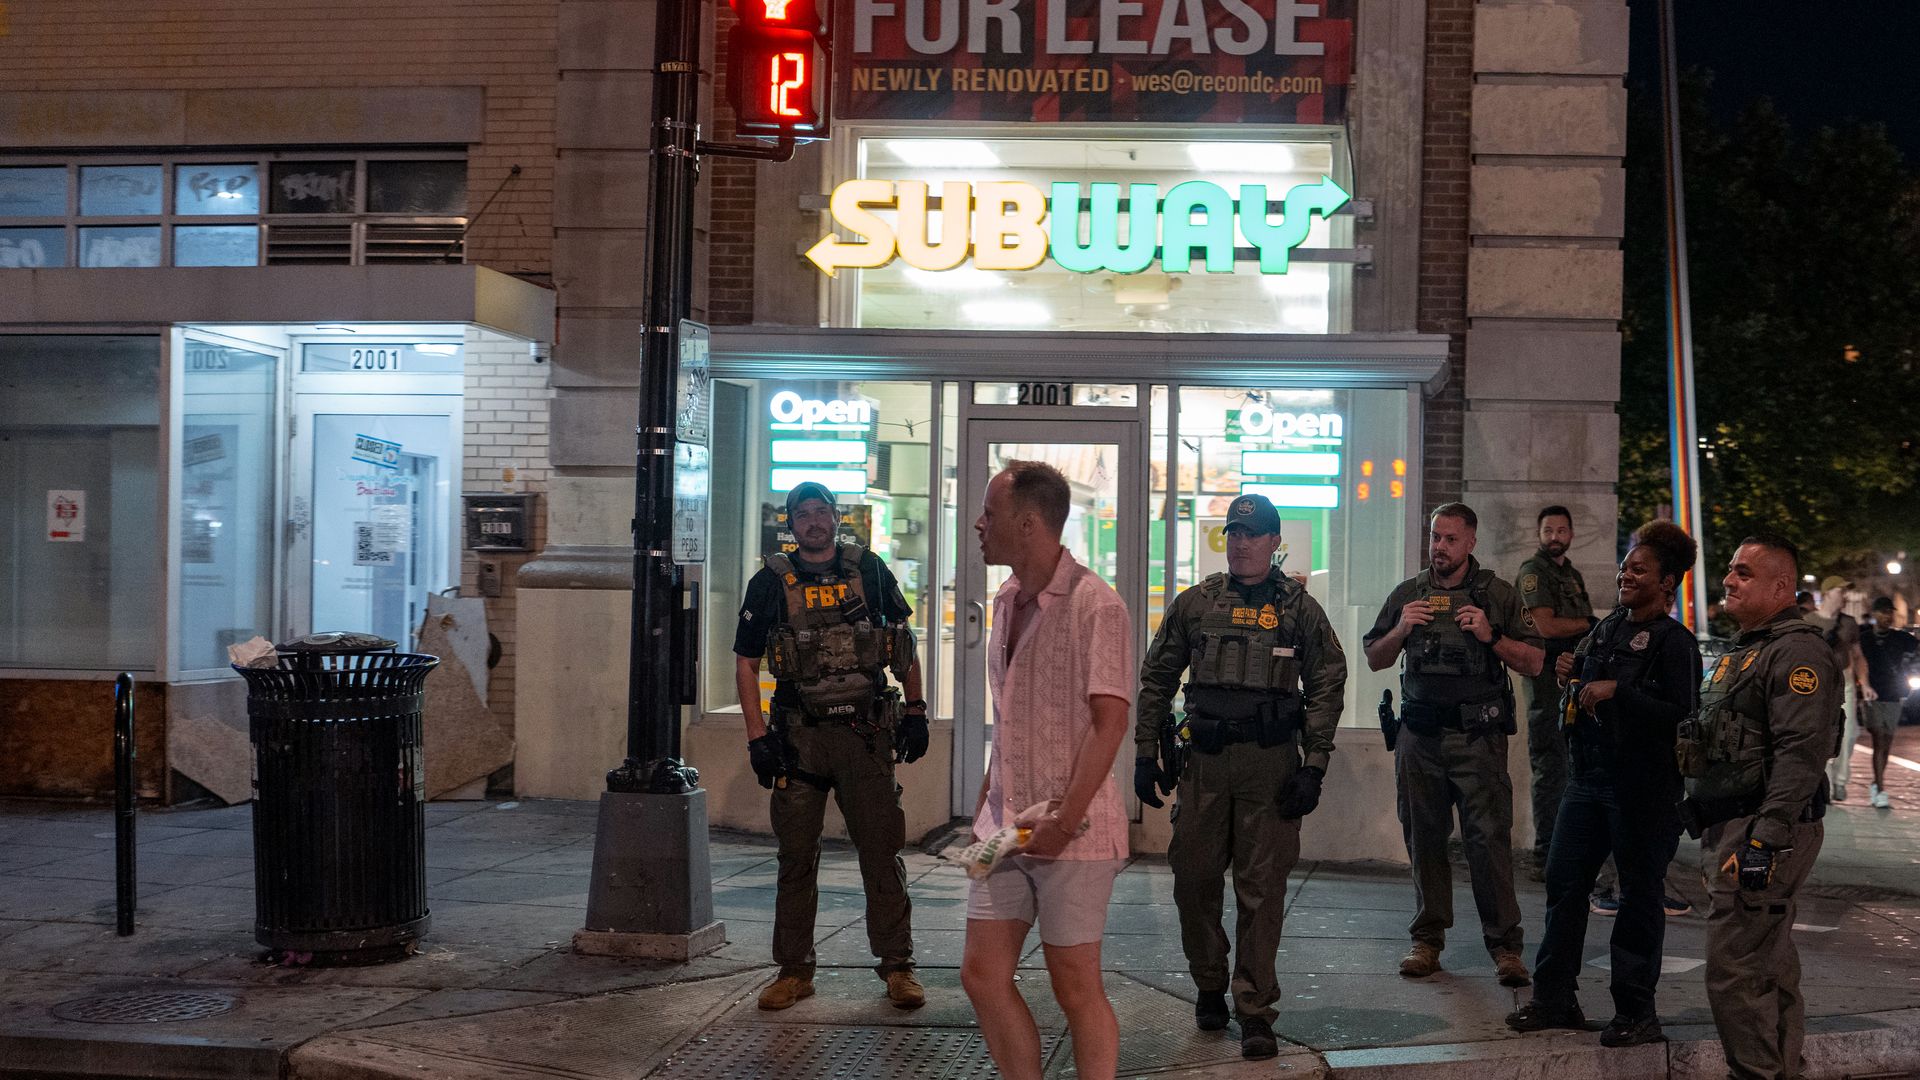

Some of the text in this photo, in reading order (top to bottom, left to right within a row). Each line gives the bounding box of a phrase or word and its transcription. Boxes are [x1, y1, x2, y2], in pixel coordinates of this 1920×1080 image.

[853, 0, 1324, 56] FOR LEASE
[770, 52, 804, 116] 12
[852, 68, 1323, 95] NEWLY RENOVATED wes@recondc.com
[805, 175, 1350, 278] SUBWAY
[352, 349, 398, 370] 2001
[1018, 383, 1072, 406] 2001
[770, 391, 871, 431] Open
[1239, 403, 1343, 444] Open
[679, 497, 699, 512] YIELD
[482, 523, 510, 534] 2001
[686, 517, 694, 532] TO
[681, 537, 698, 552] PEDS
[804, 584, 848, 609] FBI
[743, 610, 753, 622] FBI
[775, 645, 783, 670] FBI
